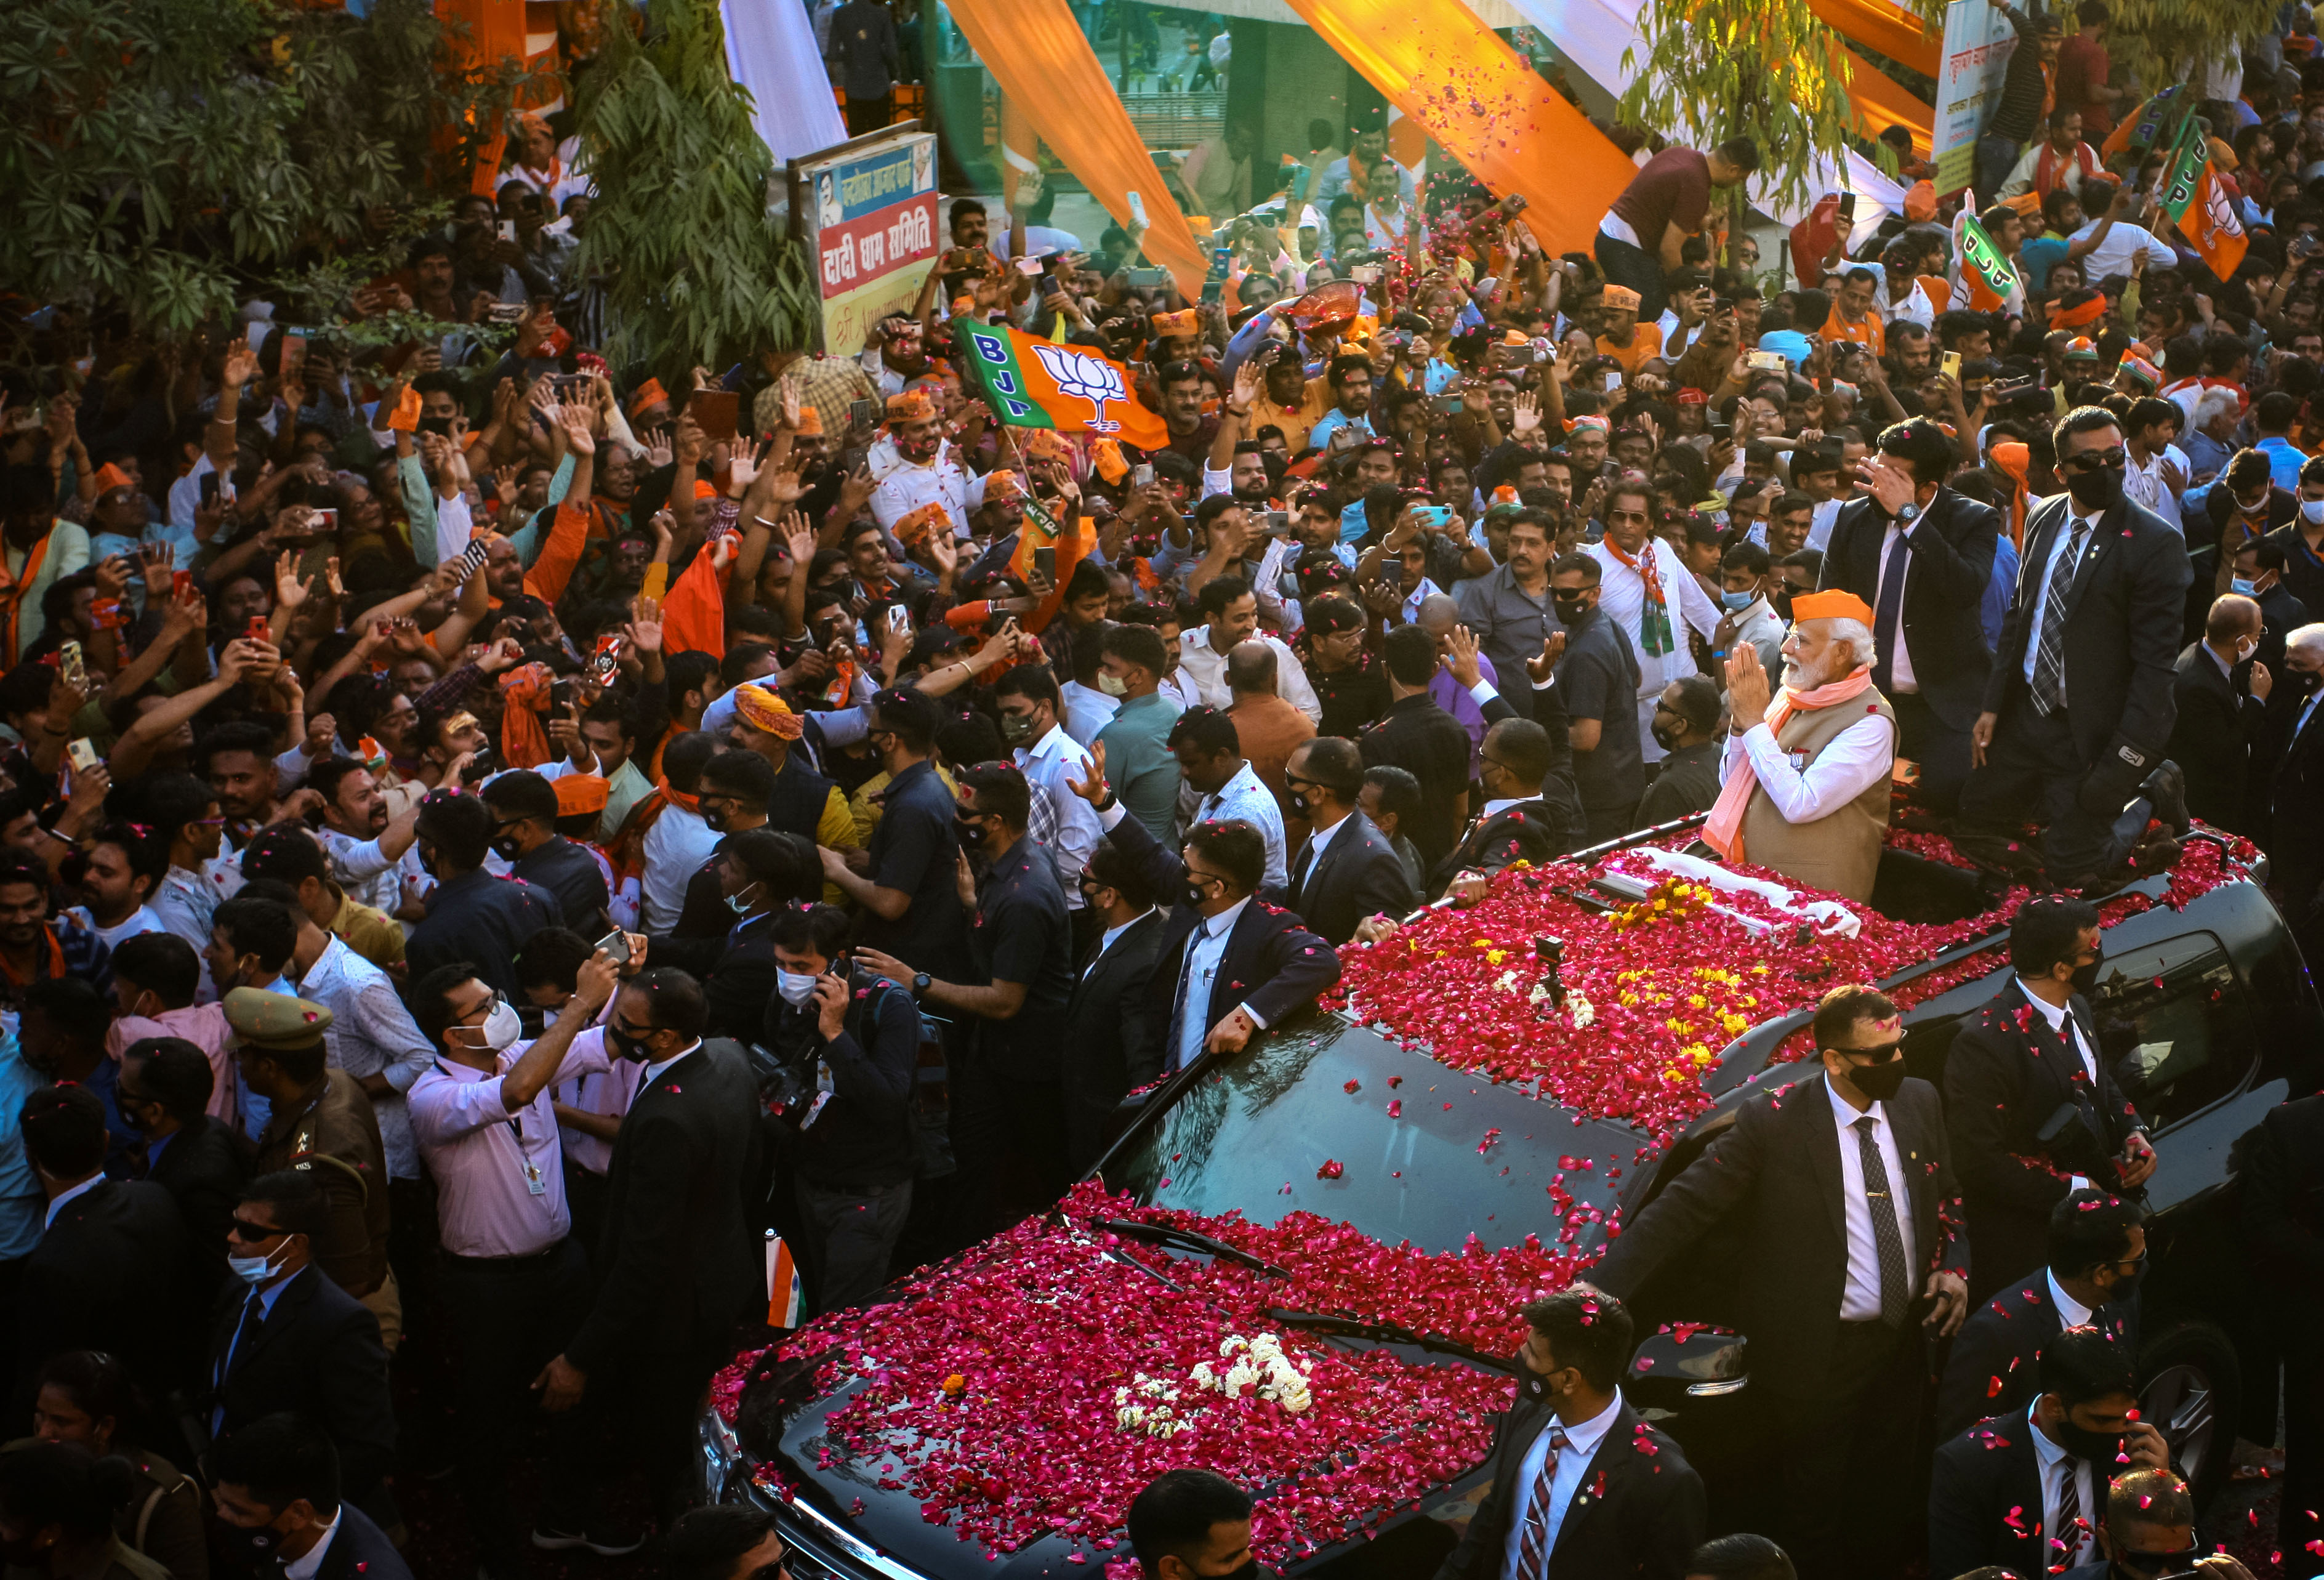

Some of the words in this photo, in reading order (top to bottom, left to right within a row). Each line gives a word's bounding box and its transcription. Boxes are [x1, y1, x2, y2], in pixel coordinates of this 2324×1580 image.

[822, 232, 857, 286] दादी
[859, 231, 885, 272] धाम
[887, 205, 931, 261] समिति
[835, 306, 853, 347] श्री
